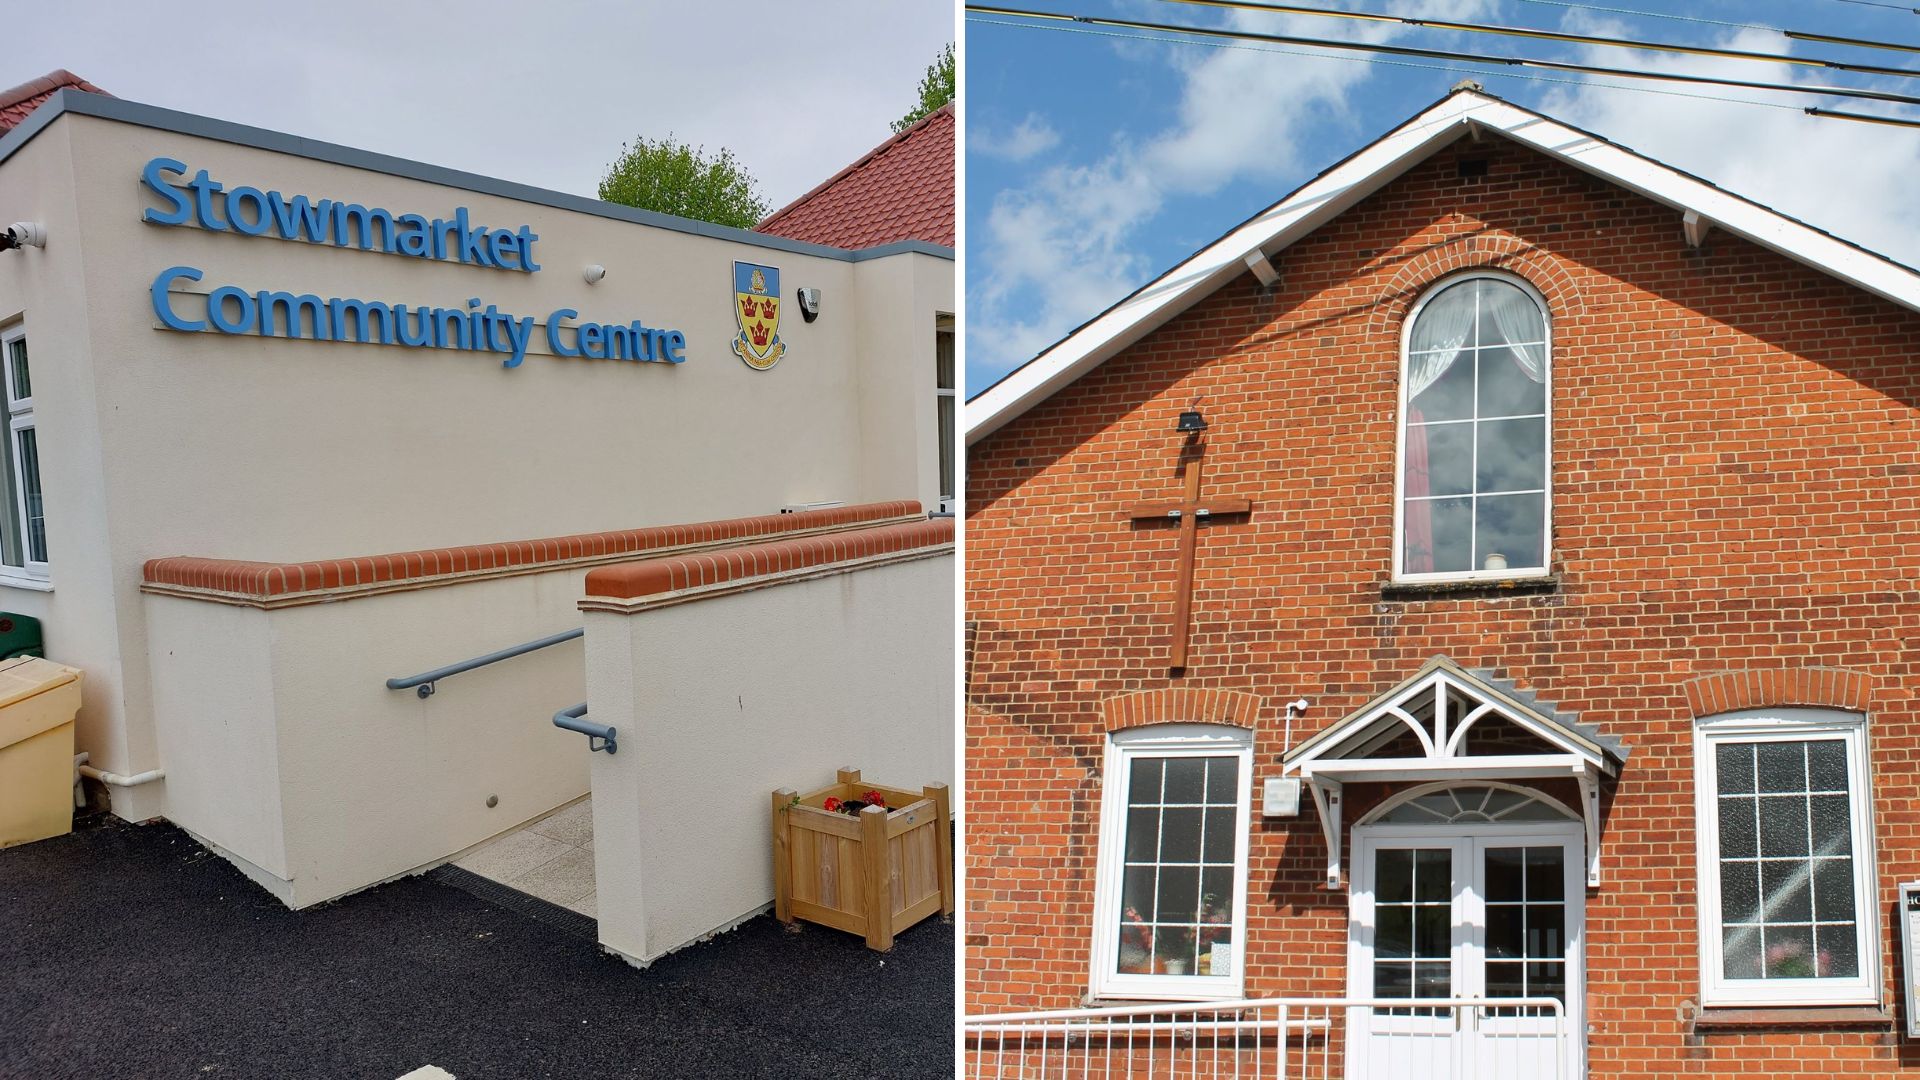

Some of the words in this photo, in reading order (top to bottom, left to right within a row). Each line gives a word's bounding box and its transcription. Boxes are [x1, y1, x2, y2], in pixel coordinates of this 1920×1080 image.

[143, 157, 541, 273] Stowmarket
[151, 266, 534, 368] Community
[547, 308, 686, 364] Centre
